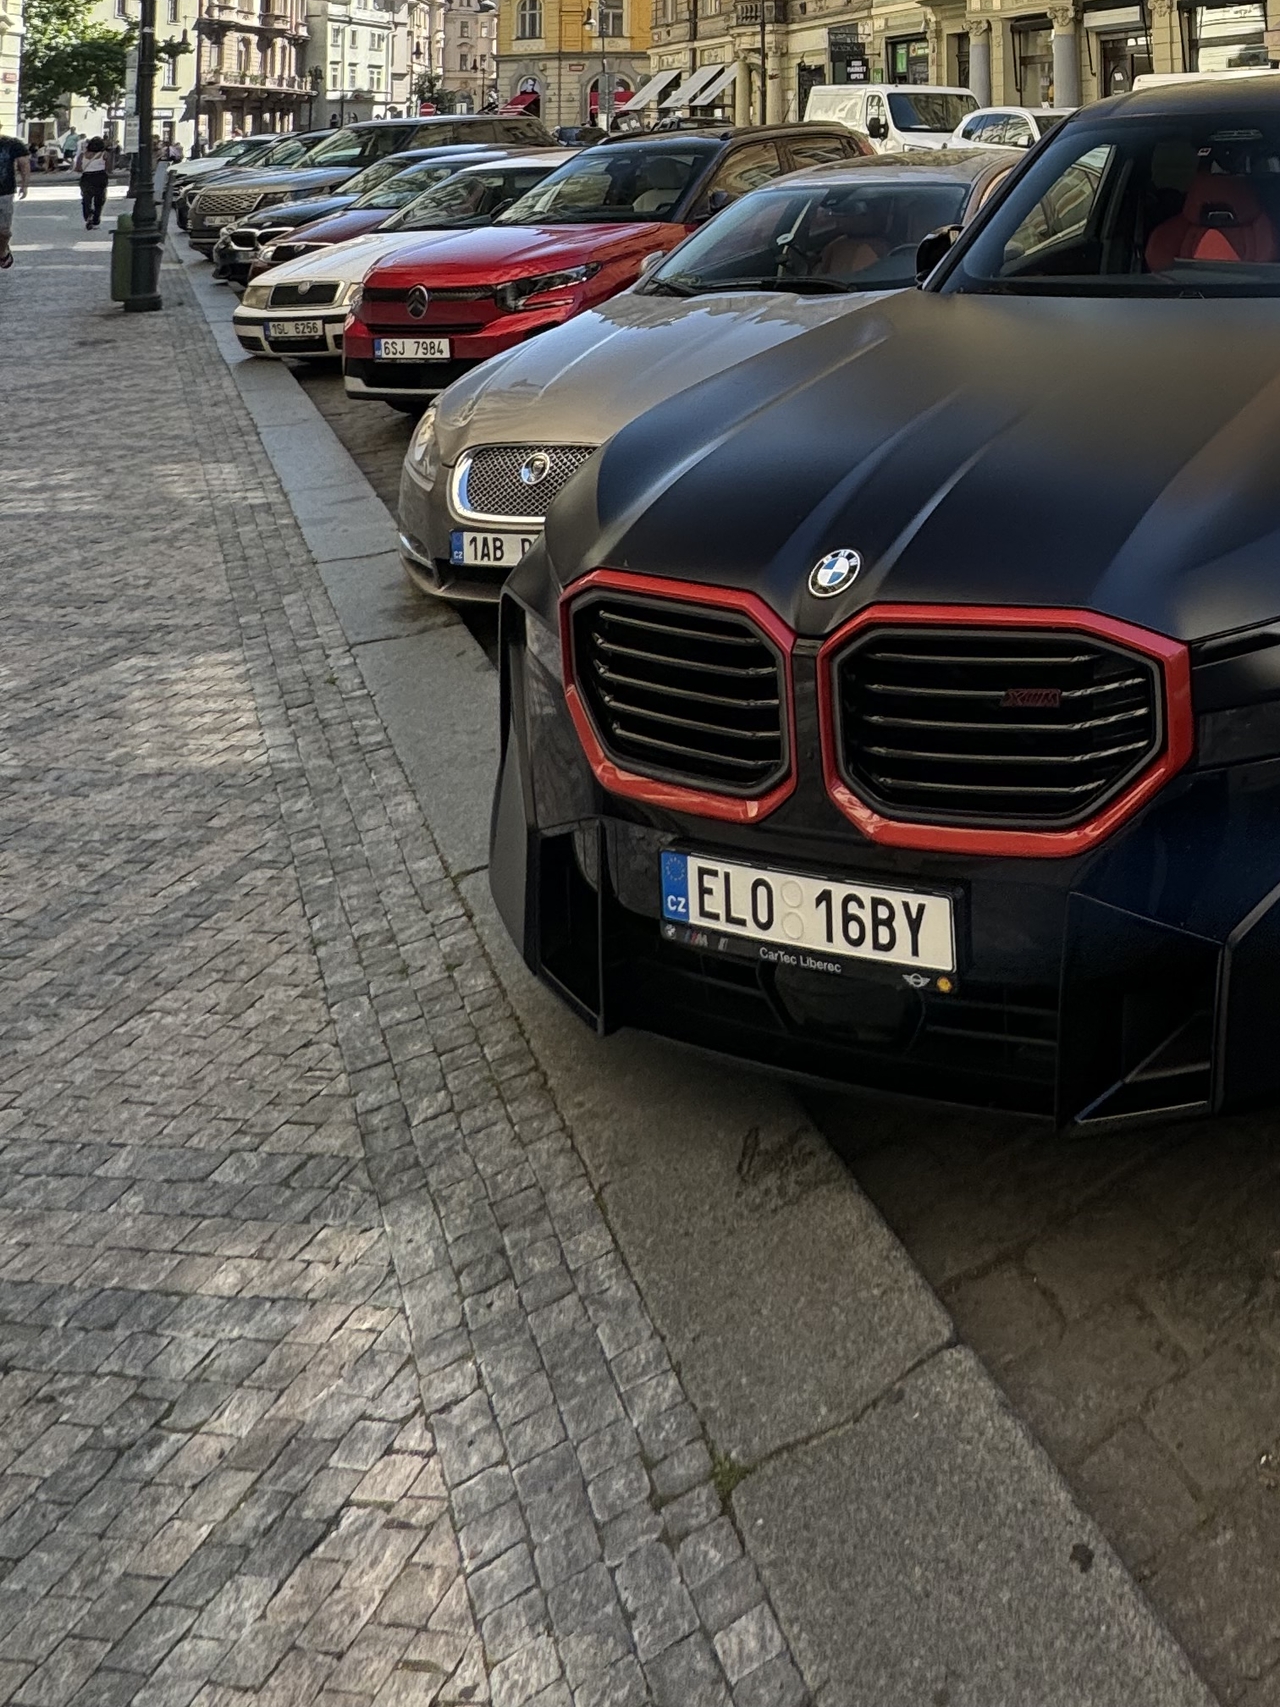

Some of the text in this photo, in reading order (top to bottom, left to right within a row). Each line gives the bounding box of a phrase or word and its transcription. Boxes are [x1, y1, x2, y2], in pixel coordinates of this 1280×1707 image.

[271, 322, 318, 335] 1SL 6256
[383, 341, 444, 356] 6SJ 7984
[453, 550, 463, 559] CZ
[469, 536, 504, 562] 1AB
[667, 894, 687, 913] CZ
[815, 888, 926, 958] 16BY
[759, 946, 842, 973] CarTec Liberec
